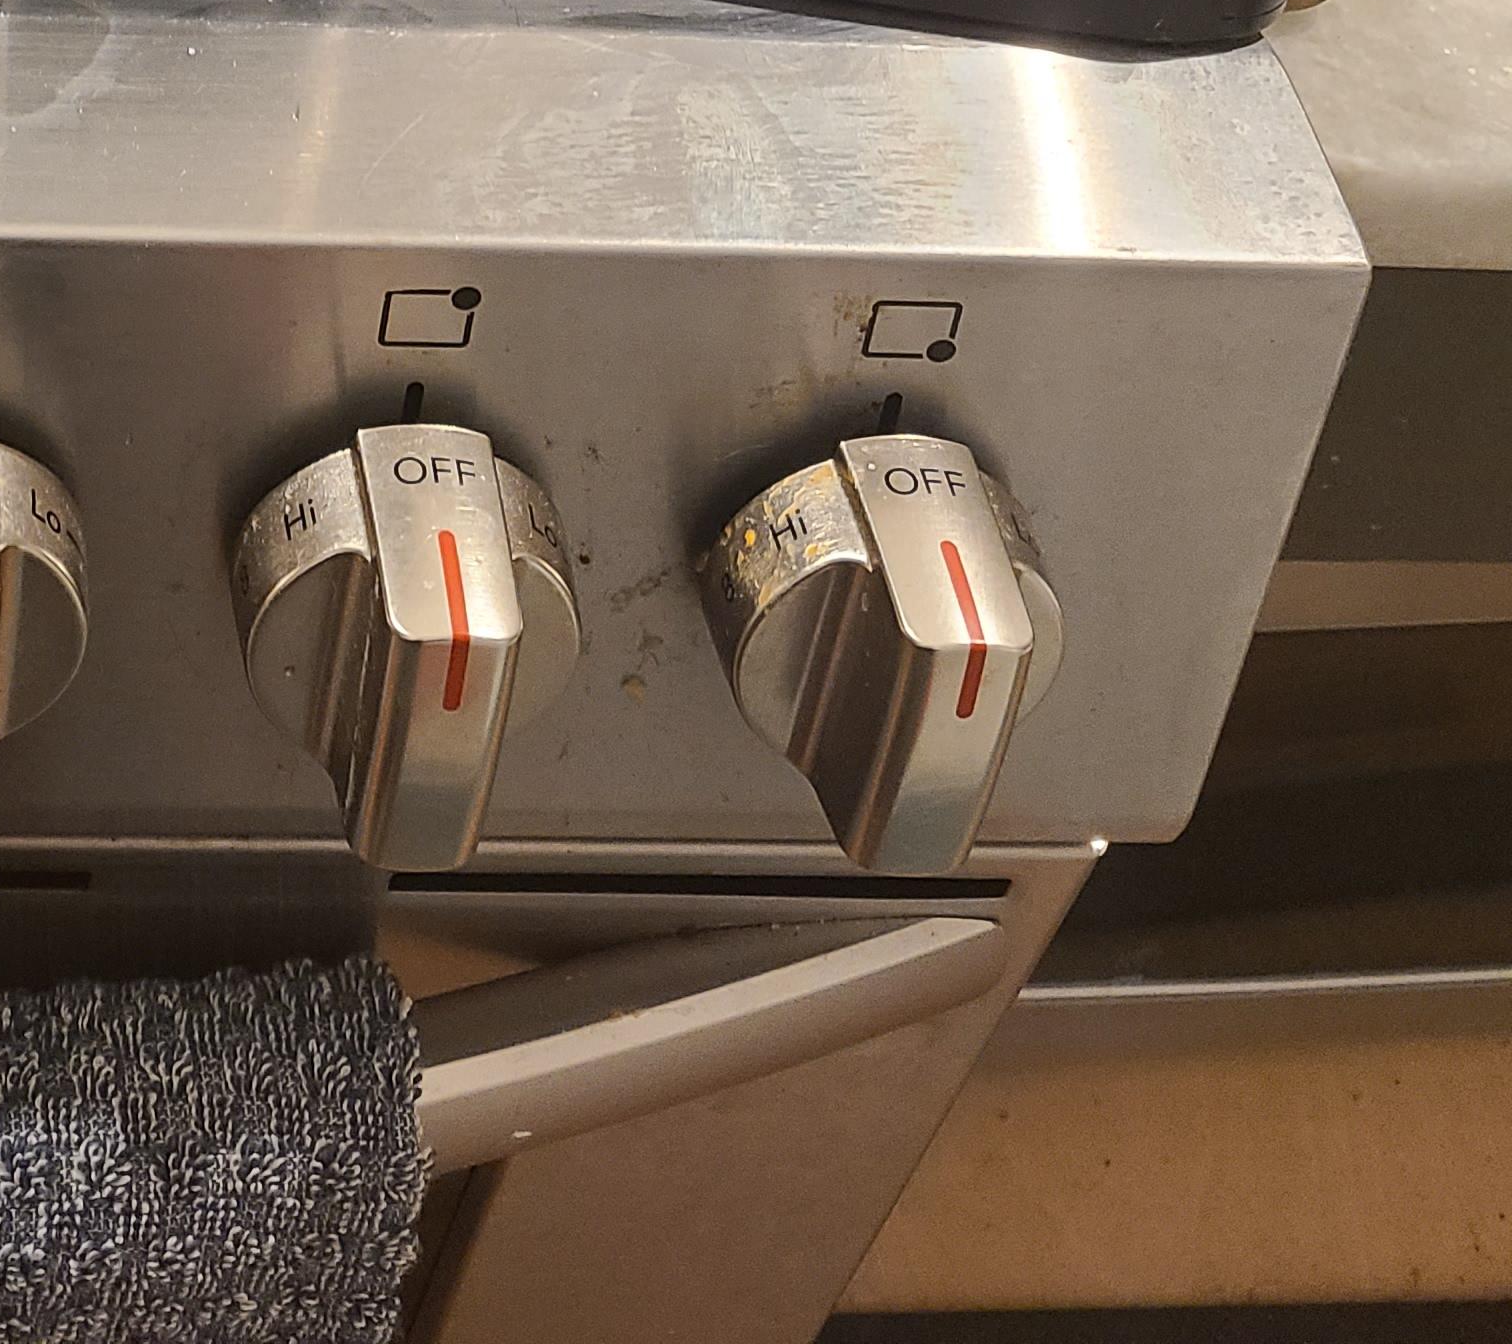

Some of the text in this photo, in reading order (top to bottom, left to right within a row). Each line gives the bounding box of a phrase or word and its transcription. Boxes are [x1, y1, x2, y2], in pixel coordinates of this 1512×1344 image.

[393, 456, 477, 486] OFF
[884, 467, 967, 497] OFF
[31, 488, 62, 534] Lo
[284, 499, 316, 541] Hi
[528, 503, 558, 548] Lo
[769, 509, 808, 551] Hi
